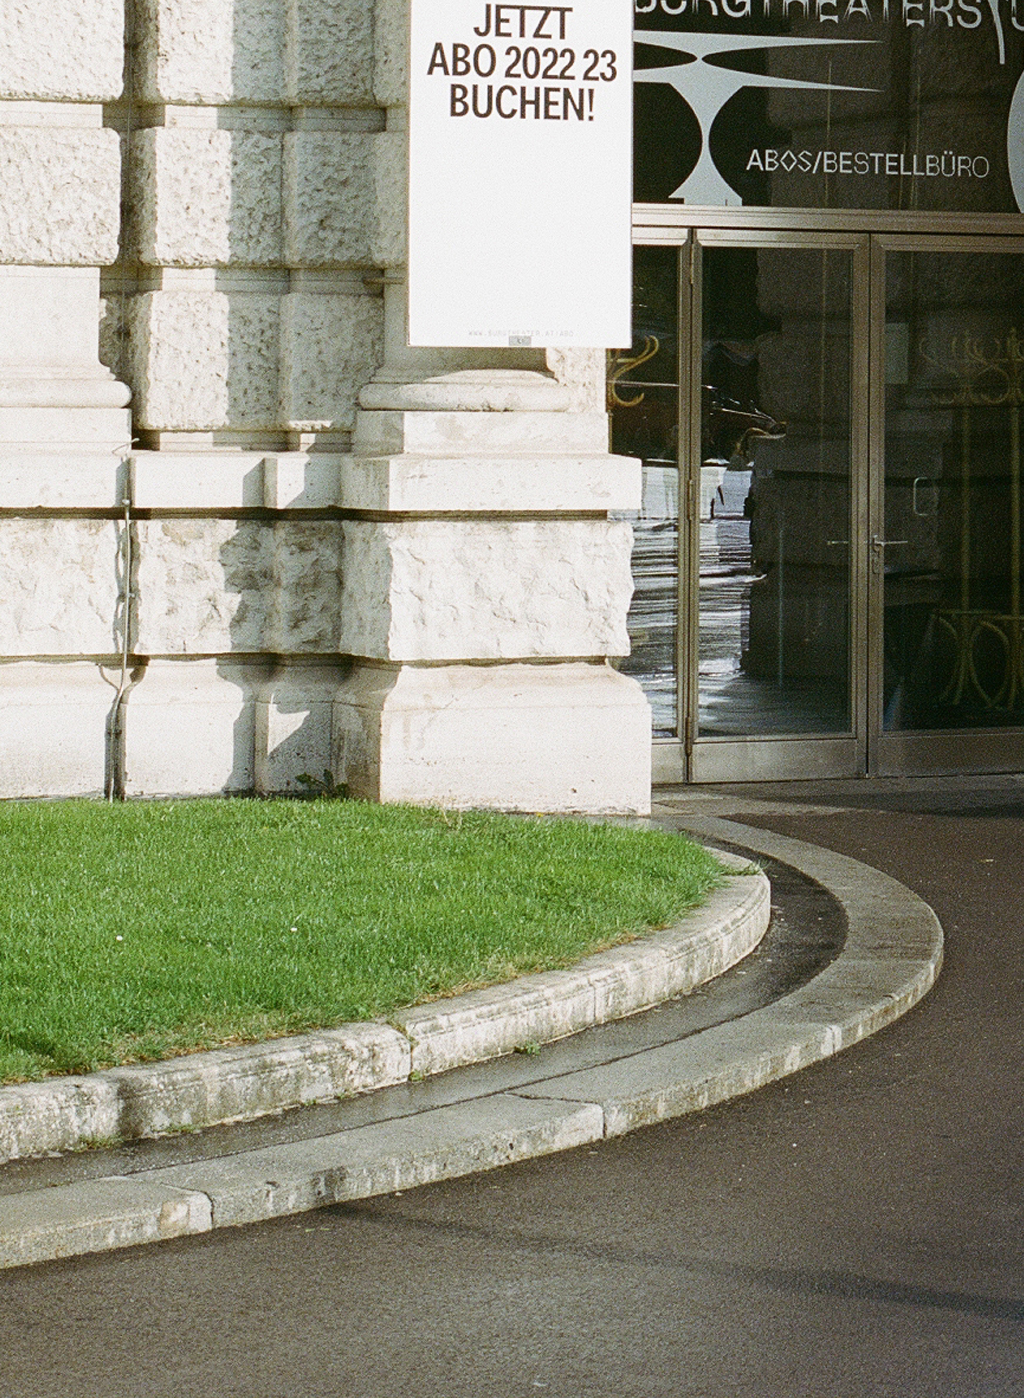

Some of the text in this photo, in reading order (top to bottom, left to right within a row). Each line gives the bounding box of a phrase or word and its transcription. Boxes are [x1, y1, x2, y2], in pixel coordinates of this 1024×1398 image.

[473, 3, 573, 40] JETZT
[427, 42, 618, 83] ABO 2022 23
[450, 83, 595, 122] BUCHEN!
[746, 148, 990, 179] ABOS/BESTELLBÜRO
